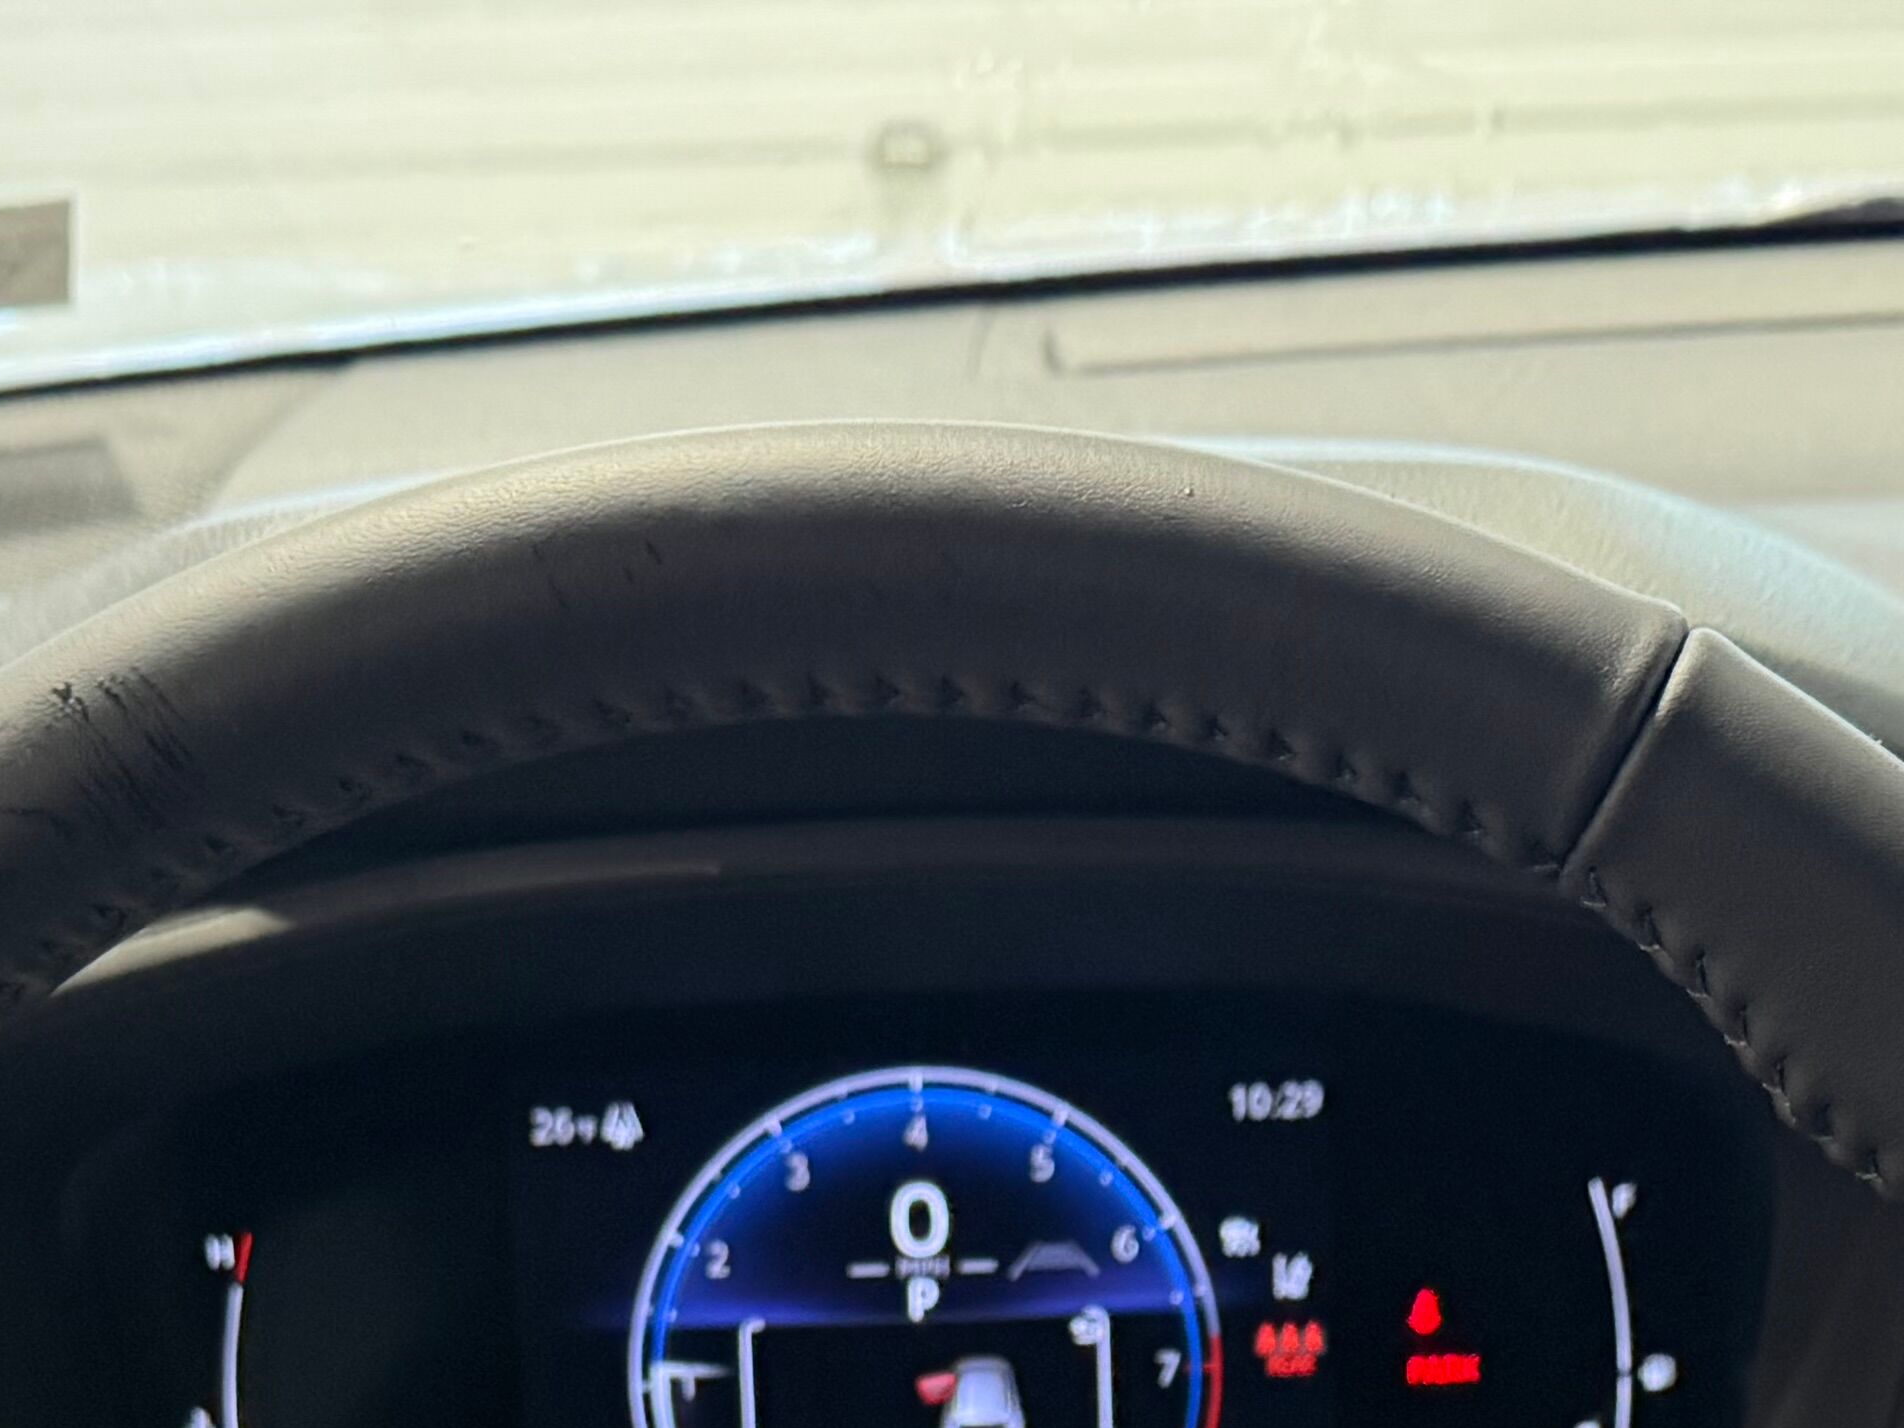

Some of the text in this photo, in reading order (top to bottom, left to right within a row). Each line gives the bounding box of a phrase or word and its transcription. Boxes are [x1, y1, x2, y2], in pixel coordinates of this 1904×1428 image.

[1230, 1079, 1324, 1122] 10:29
[903, 1115, 929, 1151] 4
[786, 1151, 810, 1191] 3
[1030, 1145, 1054, 1182] 5
[891, 1179, 949, 1259] 0
[707, 1239, 730, 1279] 2
[1111, 1224, 1139, 1263] 6
[908, 1277, 940, 1322] P
[1154, 1348, 1181, 1388] 7
